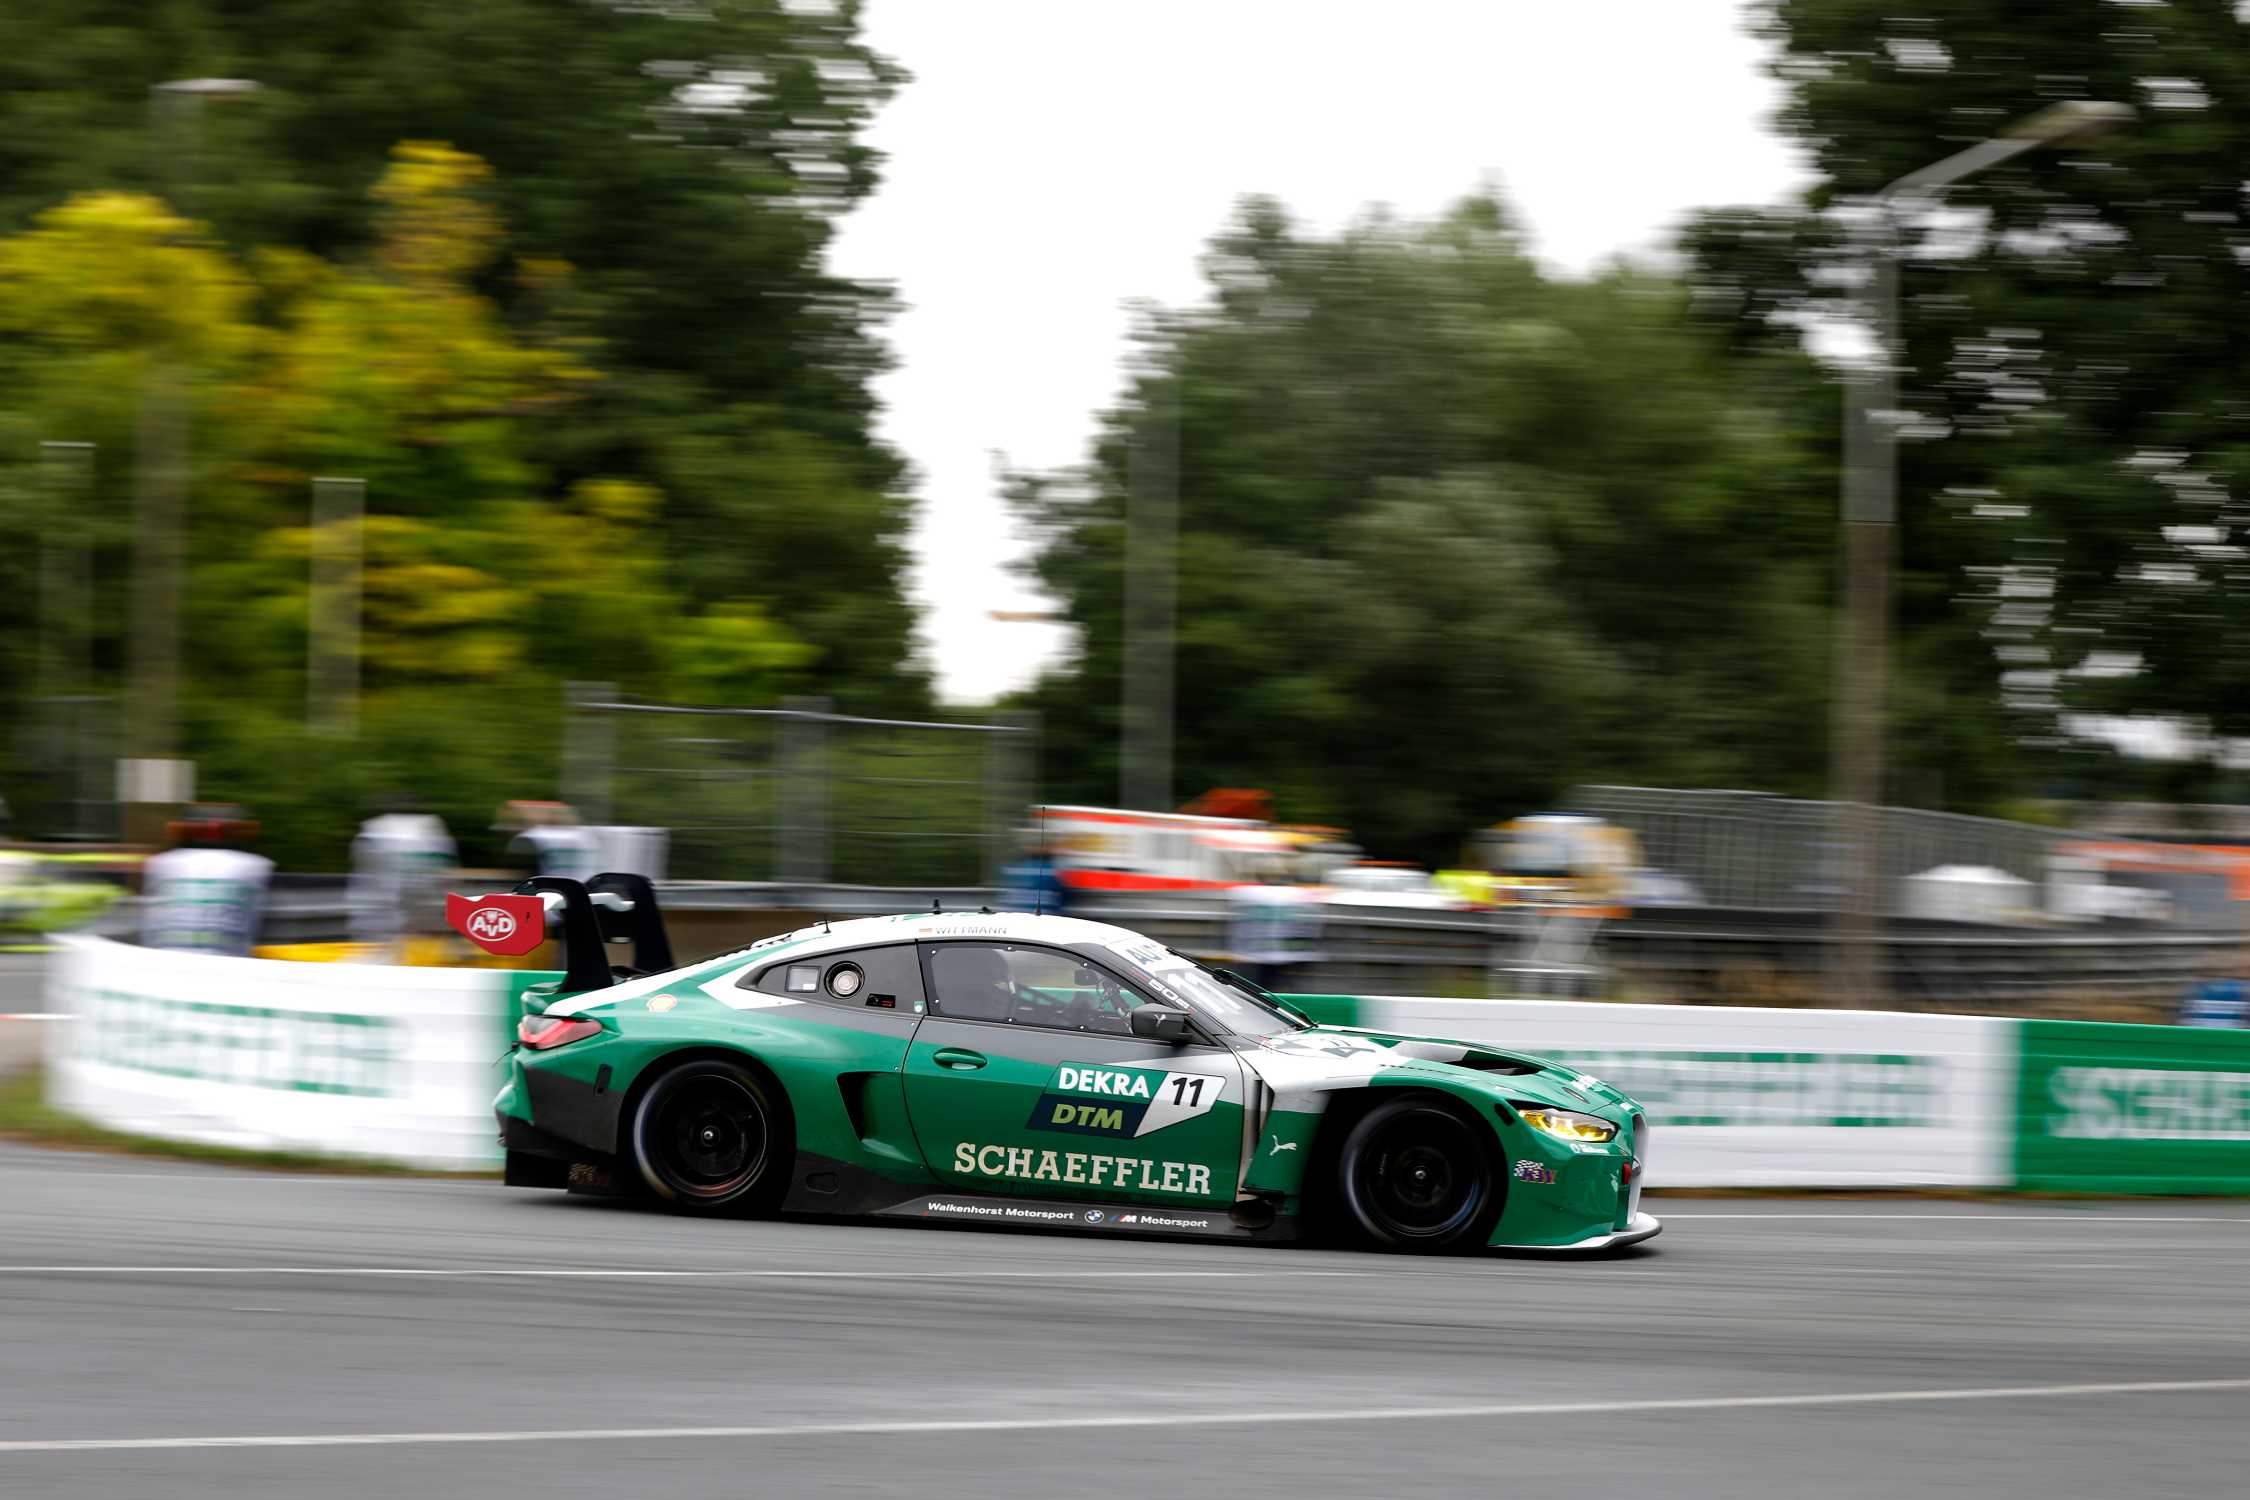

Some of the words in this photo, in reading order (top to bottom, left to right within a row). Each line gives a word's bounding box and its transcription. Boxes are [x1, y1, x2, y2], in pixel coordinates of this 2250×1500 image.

[935, 926, 1008, 936] WITTMANN
[1058, 1067, 1151, 1099] DEKRA
[1171, 1076, 1205, 1108] 11
[1051, 1103, 1124, 1131] DTM
[954, 1142, 1212, 1195] SCHAEFFLER
[927, 1202, 1003, 1216] Walkenhorst
[1005, 1207, 1075, 1220] Motorsport
[1140, 1215, 1209, 1228] Motorsport
